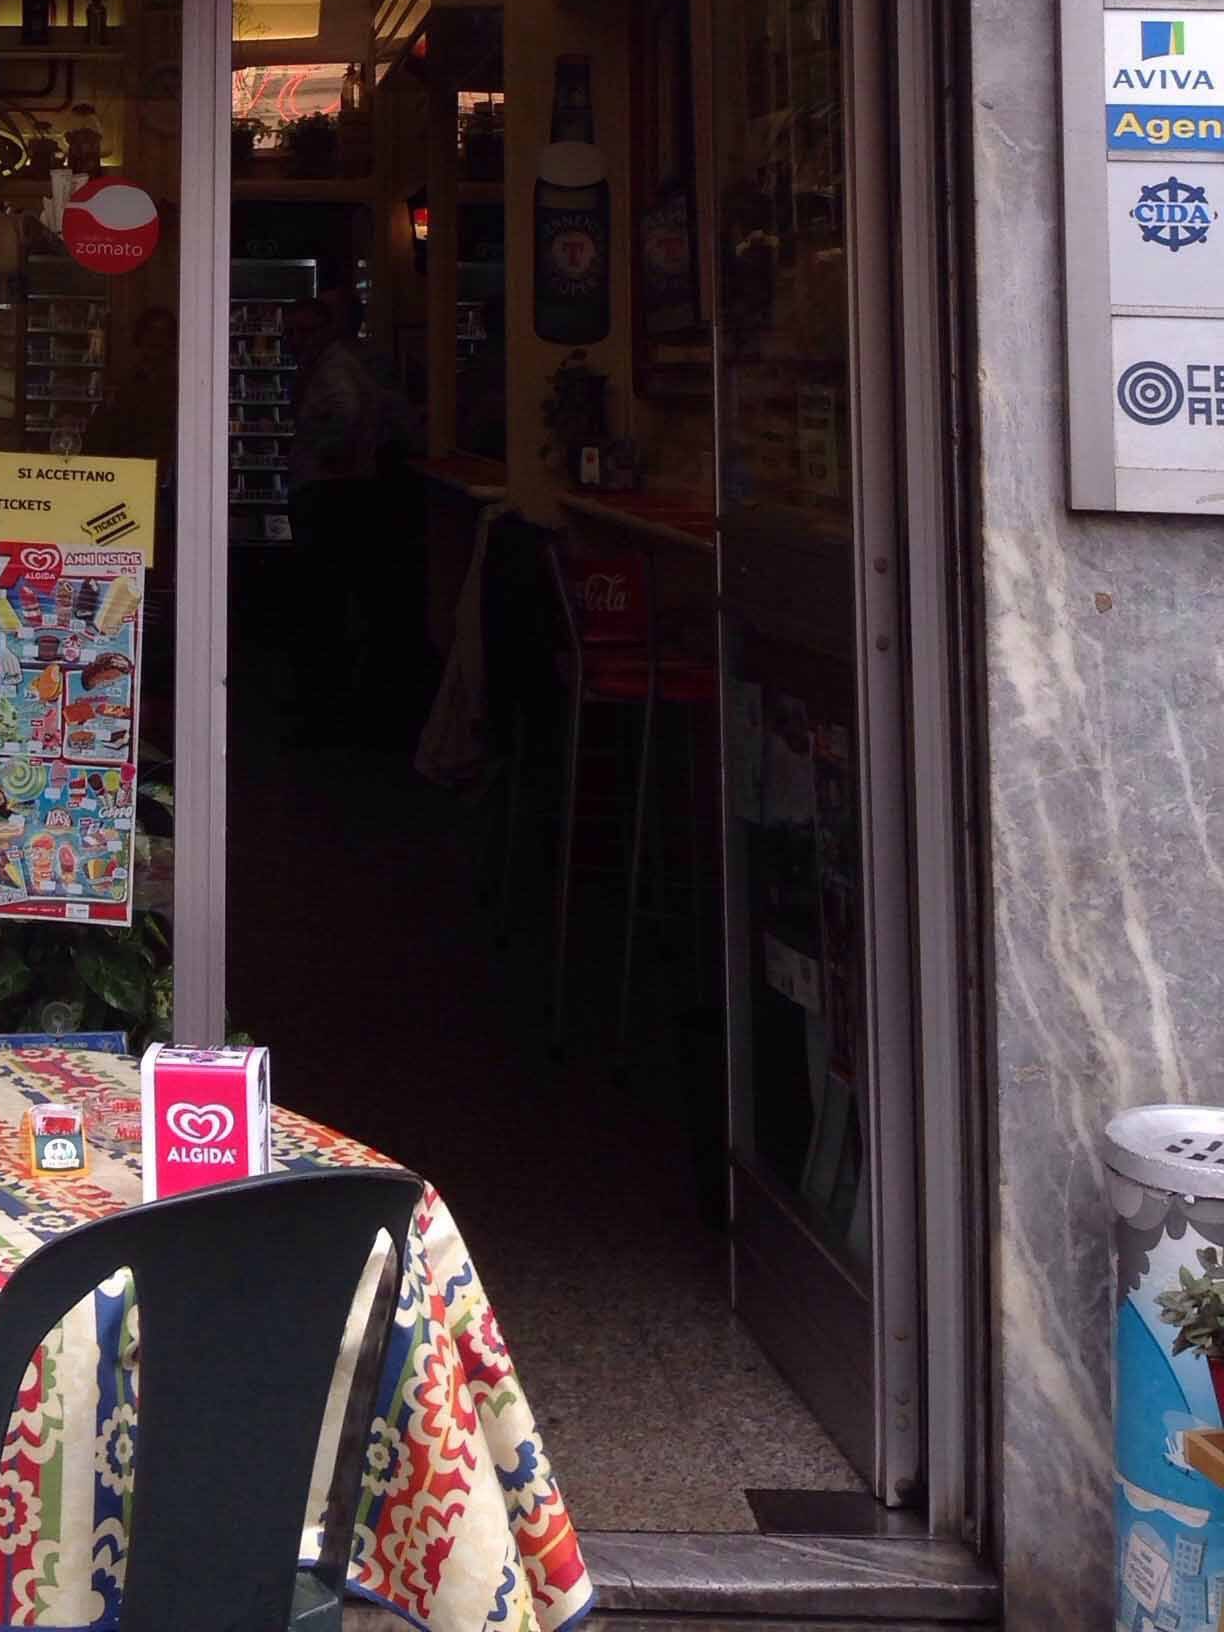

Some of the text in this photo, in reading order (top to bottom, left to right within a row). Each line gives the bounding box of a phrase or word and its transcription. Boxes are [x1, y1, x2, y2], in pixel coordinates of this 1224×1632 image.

[1112, 69, 1215, 90] AVIVA
[1113, 112, 1224, 144] Agen
[1134, 204, 1211, 224] CIDA
[75, 242, 143, 257] zomato
[18, 468, 115, 482] SI ACCETTANO
[167, 1147, 235, 1165] ALGIDA
